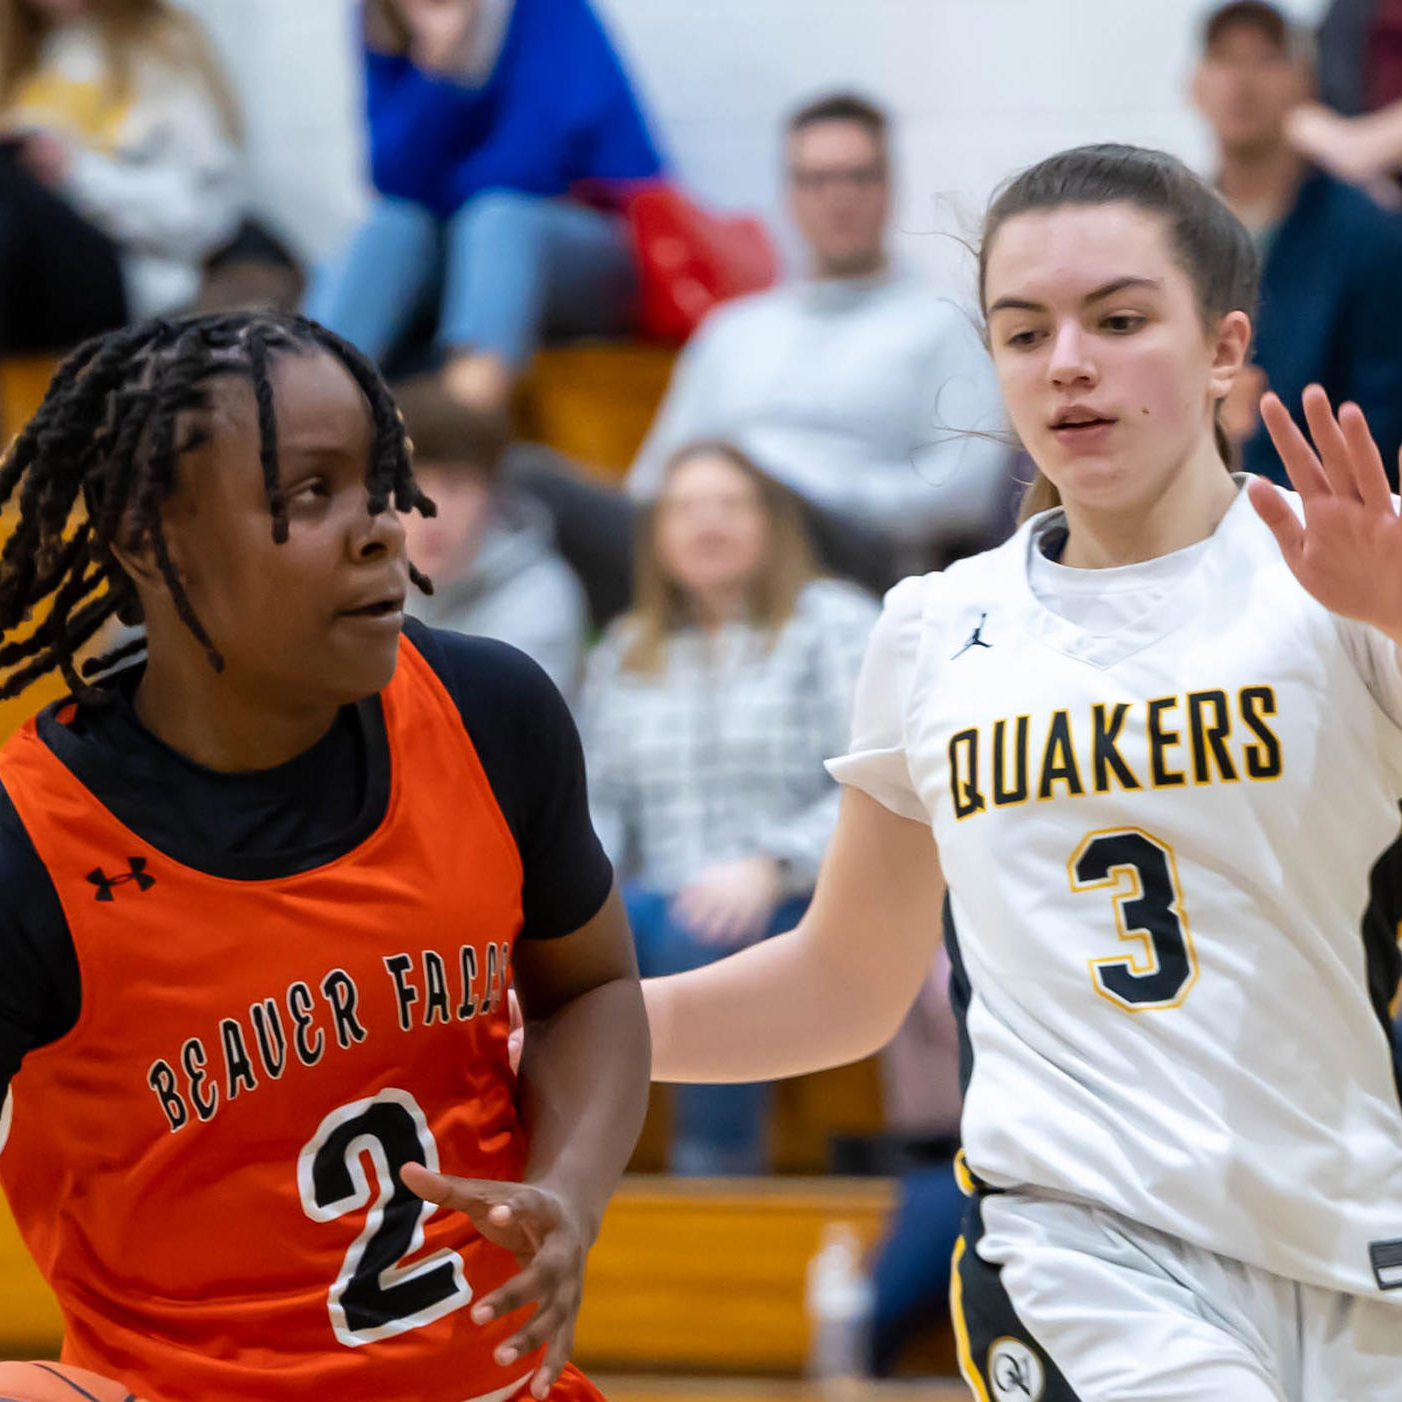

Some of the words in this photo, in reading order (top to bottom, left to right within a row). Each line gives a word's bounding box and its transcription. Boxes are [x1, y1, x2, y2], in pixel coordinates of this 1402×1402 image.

[947, 684, 1284, 821] QUAKERS
[1066, 825, 1199, 1012] 3
[147, 968, 367, 1133] BEAVER
[297, 1087, 473, 1348] 2
